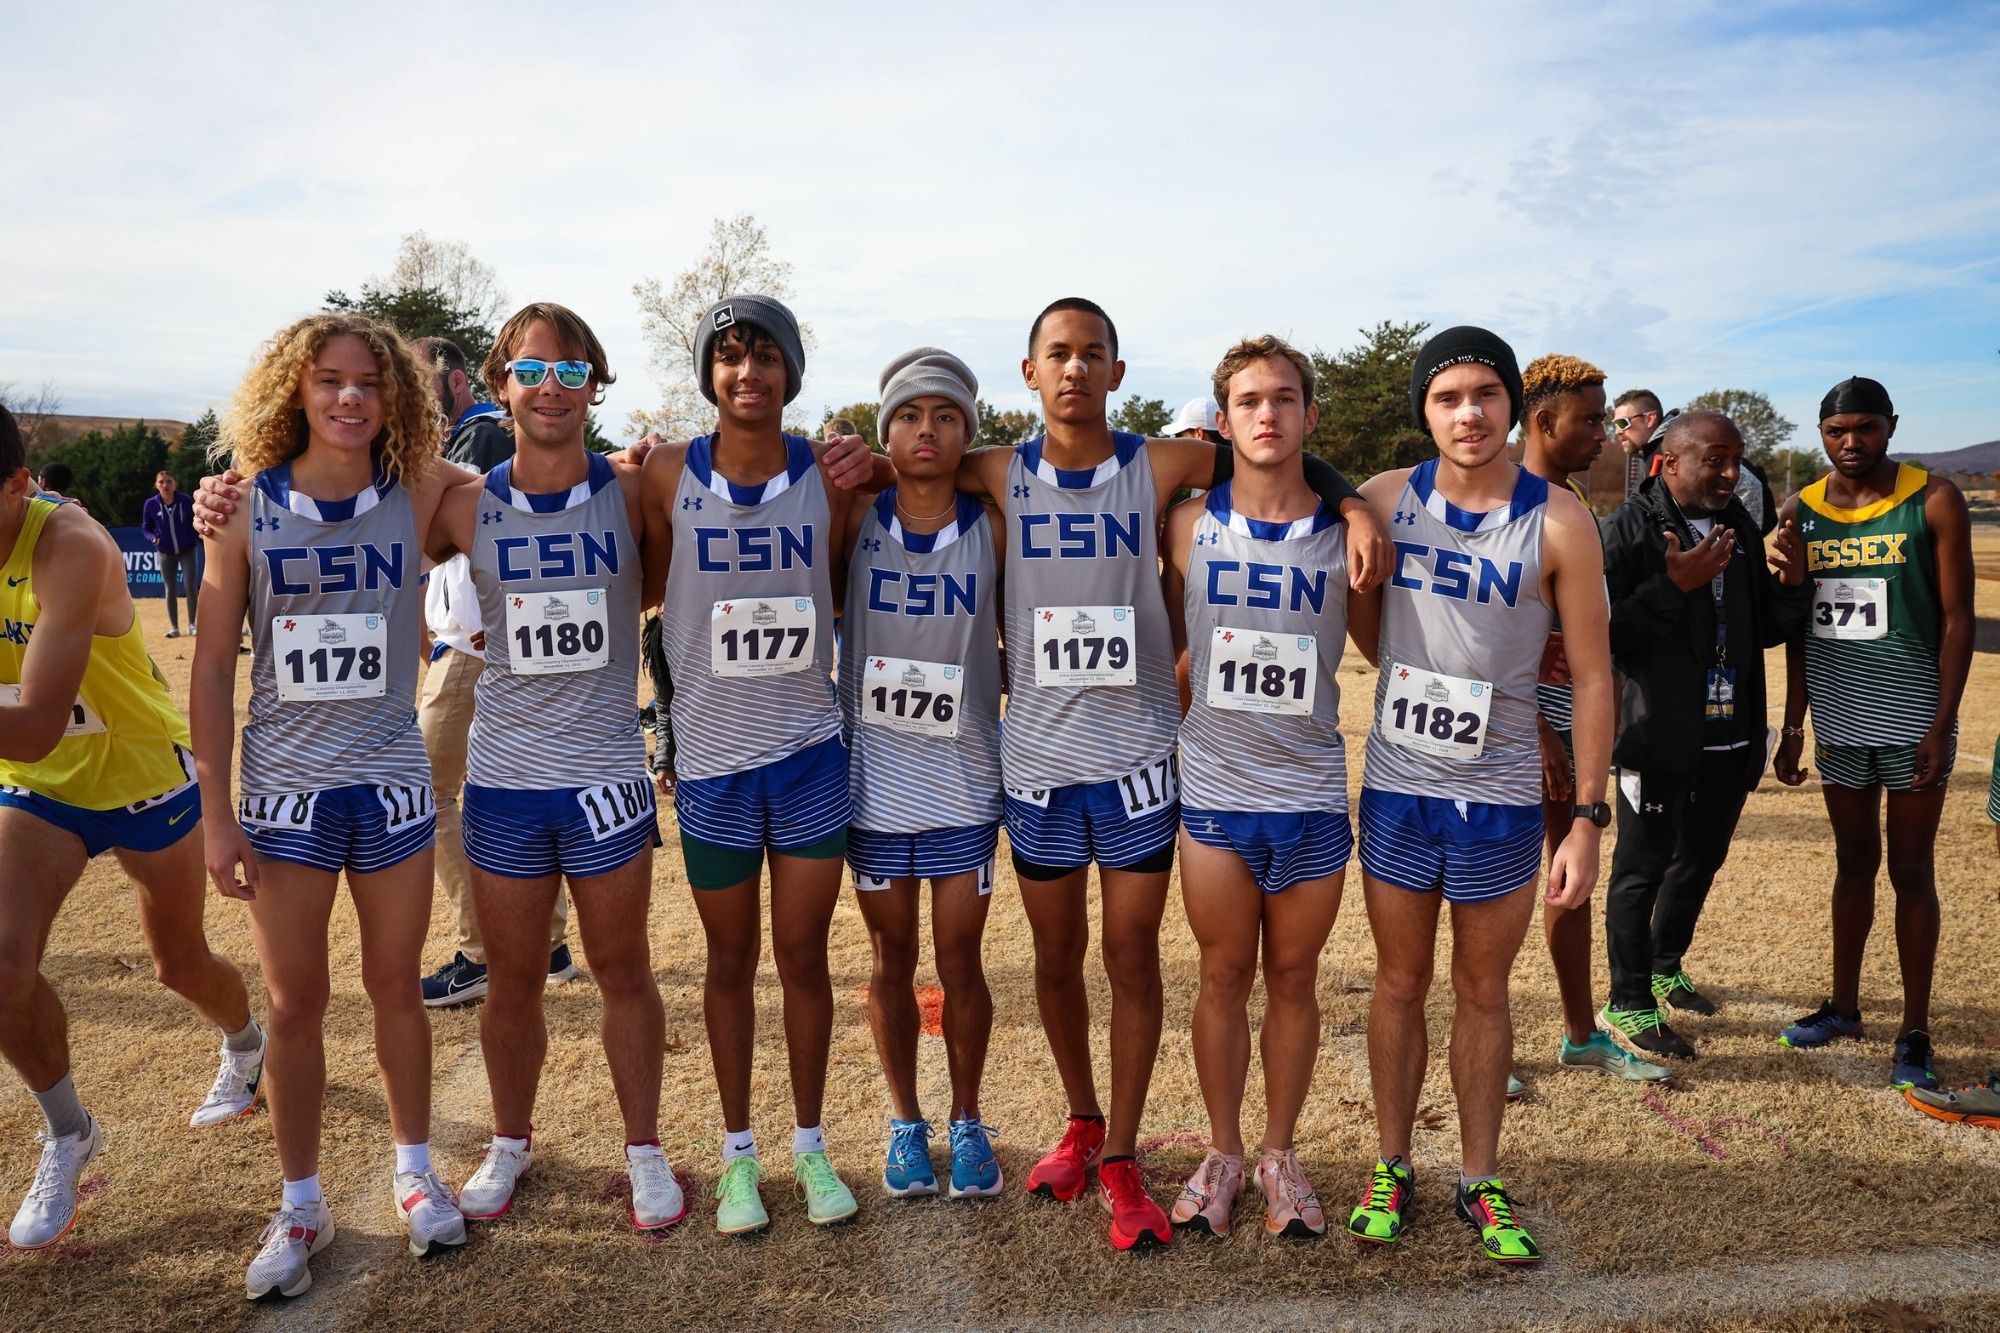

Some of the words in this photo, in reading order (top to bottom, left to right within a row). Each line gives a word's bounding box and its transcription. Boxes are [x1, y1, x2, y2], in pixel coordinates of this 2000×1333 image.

[1479, 358, 1495, 366] YOU
[692, 524, 814, 572] CSN
[1016, 511, 1142, 560] CSN
[1807, 533, 1907, 571] ESSEX
[123, 551, 182, 571] NTSV
[261, 542, 405, 597] CSN
[491, 530, 620, 582] CSN
[1391, 540, 1524, 609] CSN
[868, 567, 977, 617] CSN
[1204, 560, 1328, 616] CSN
[1816, 601, 1876, 626] 371
[516, 620, 603, 657] 1180
[722, 627, 809, 661] 1177
[1044, 637, 1128, 670] 1179
[285, 646, 381, 683] 1178
[1219, 660, 1306, 699] 1181
[871, 686, 954, 722] 1176
[1392, 697, 1480, 744] 1182
[1122, 752, 1179, 813] 1179
[244, 792, 314, 824] 1178
[585, 780, 648, 834] 1180
